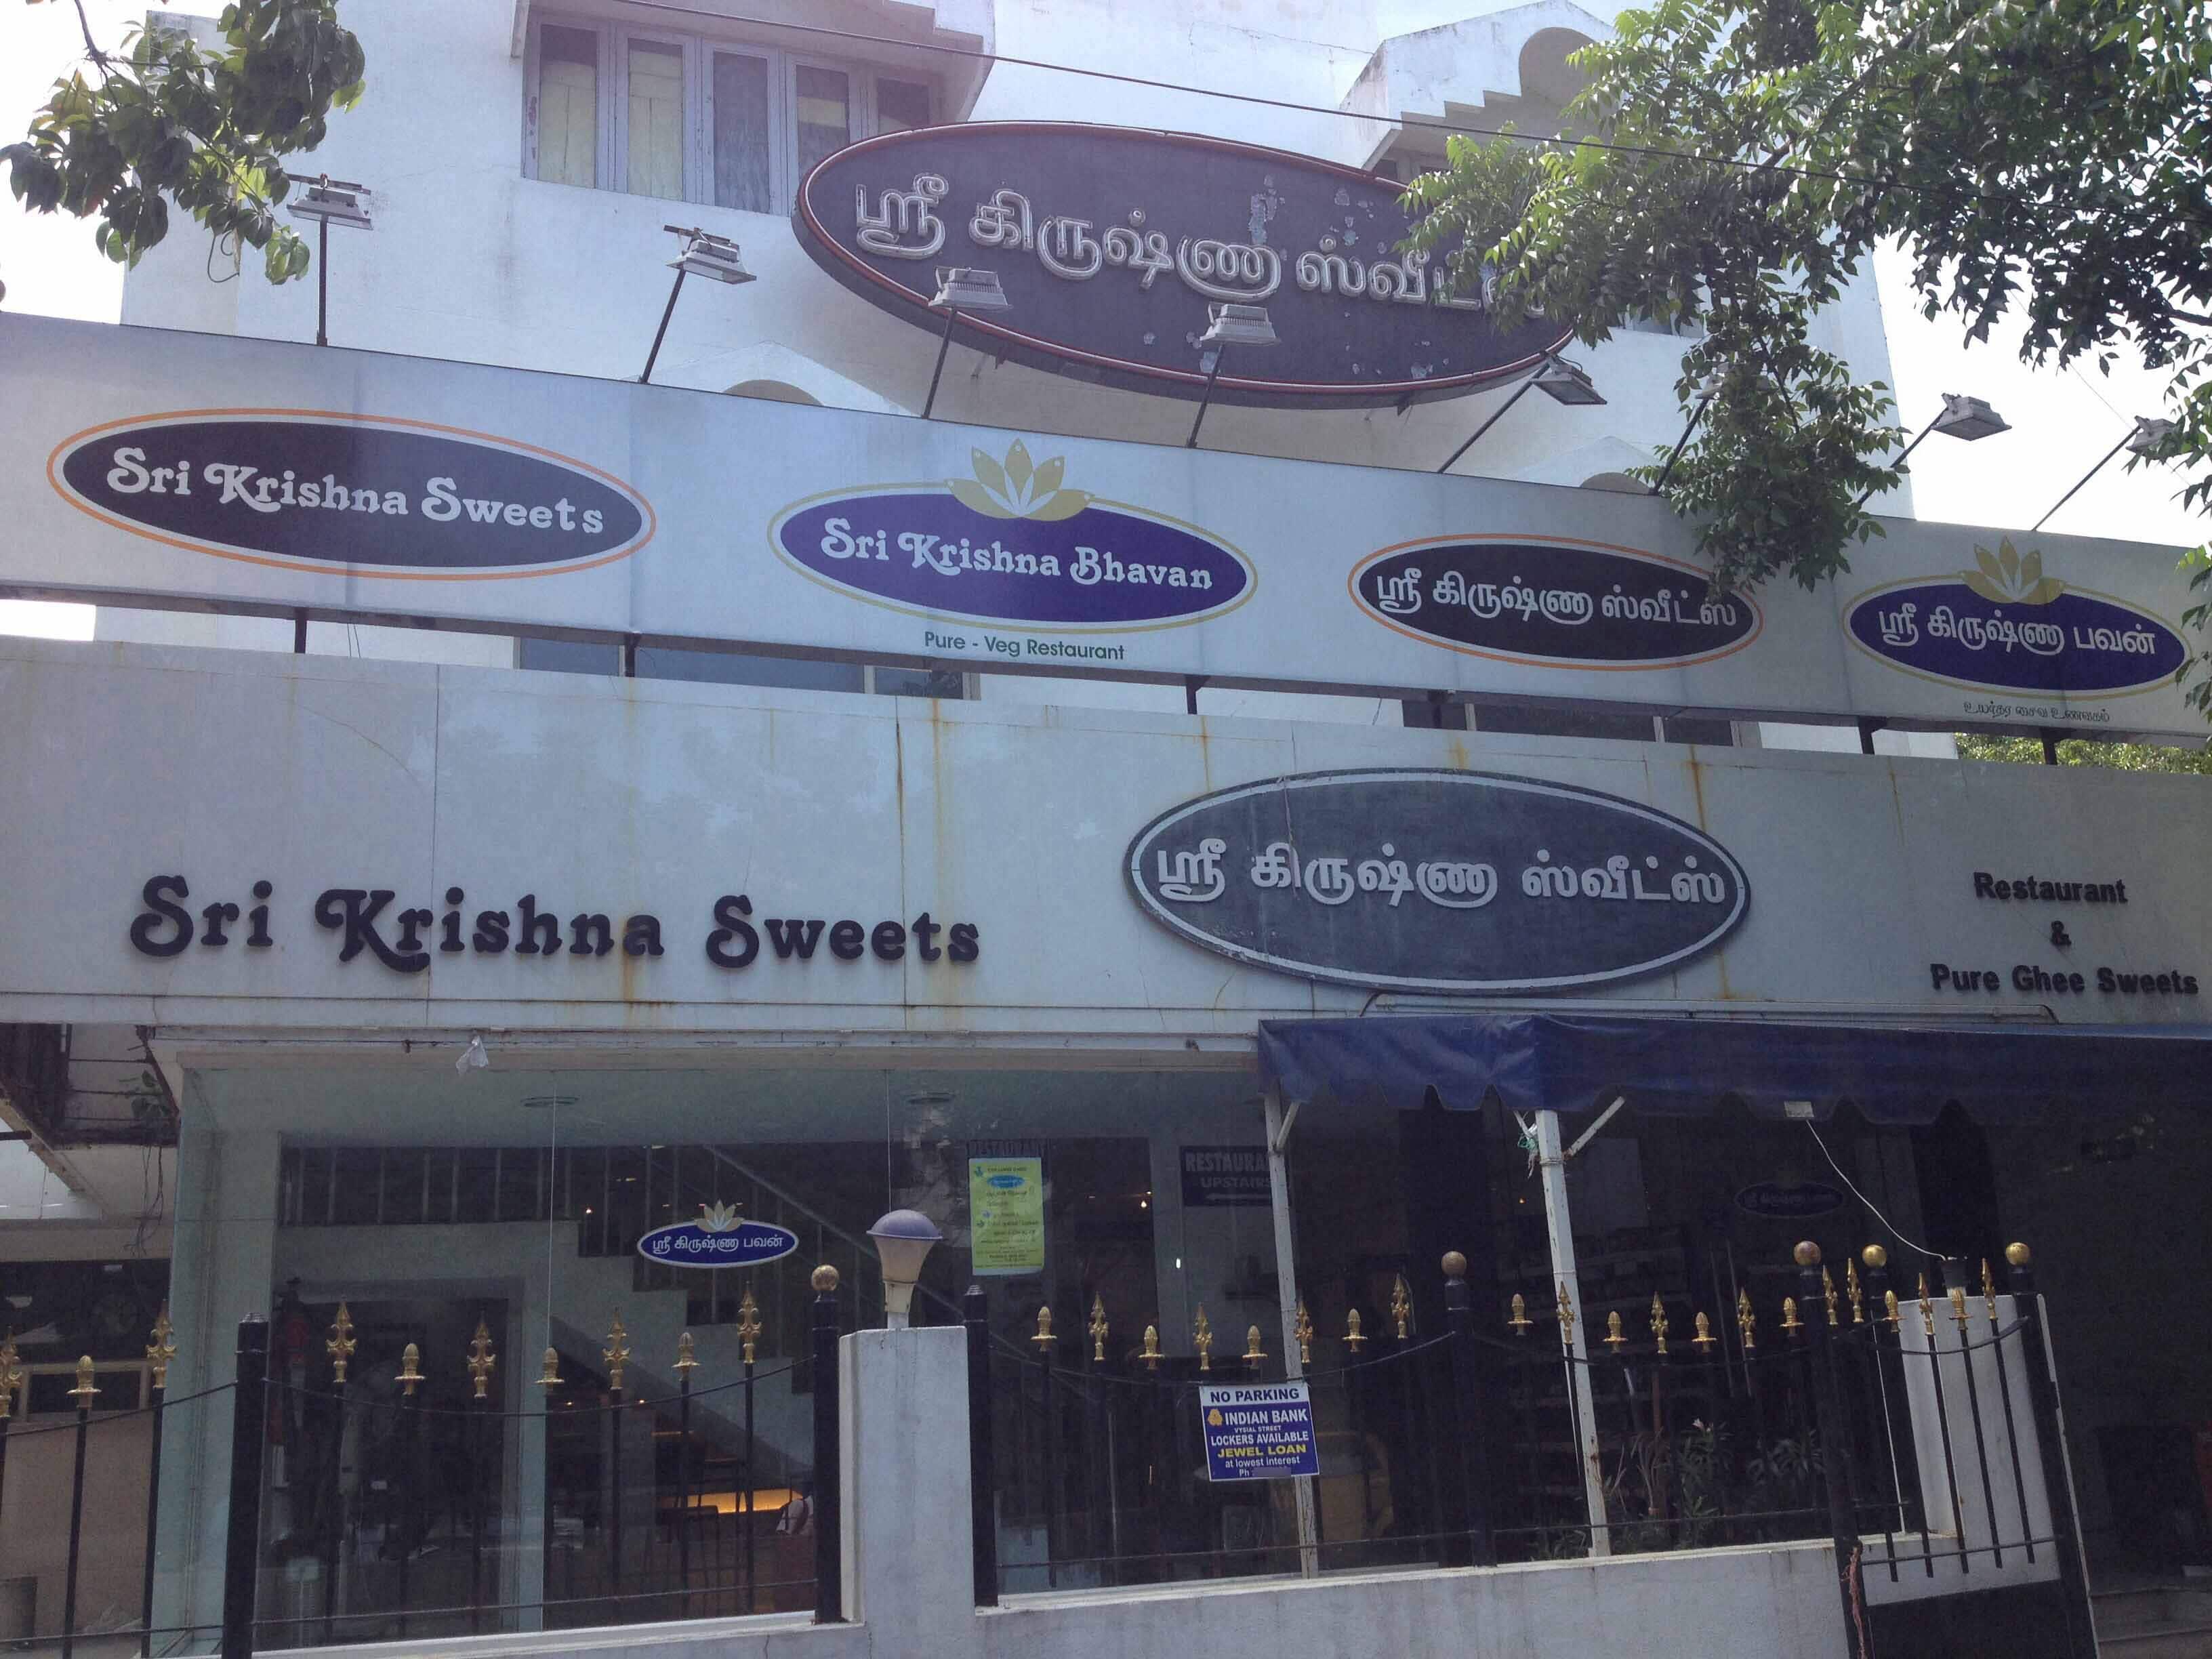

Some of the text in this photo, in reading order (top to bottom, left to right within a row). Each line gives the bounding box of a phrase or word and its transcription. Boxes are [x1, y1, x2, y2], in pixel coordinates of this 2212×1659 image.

[855, 173, 947, 258] ஸ்ரீ
[968, 188, 1281, 298] கிருஷ்ண
[106, 447, 605, 535] Sri Krishna Sweets
[820, 517, 1213, 590] Sri Krishna Bhavan
[1376, 567, 1422, 614] ஸ்ரீ
[1431, 571, 1593, 625] கிருஷ்ண
[1879, 602, 2156, 655] ஸ்ரீ கிருஷ்ண பவன்
[924, 632, 966, 651] Pure
[984, 636, 1021, 657] Veg
[1027, 639, 1125, 661] Restaurant
[1157, 838, 1725, 909] ஸ்ரீ கிருஷ்ண ஸ்வீட்ஸ்
[1973, 872, 2128, 903] Restaurant
[129, 875, 981, 974] Sri Krishna Sweets
[2050, 920, 2071, 947] &
[1930, 963, 2199, 994] Pure Ghee Sweets
[1185, 1152, 1271, 1171] RESTAURA
[653, 1234, 783, 1254] ஸ்ரீ கிருஷ்ண பவன்
[1210, 1388, 1299, 1402] NO PARKING
[1225, 1408, 1308, 1425] INDIAN BANK
[1211, 1431, 1309, 1446] LOCKERS AVAILABLE
[1218, 1444, 1307, 1458] JEWEL LOAN
[1225, 1456, 1300, 1468] at lowest interest
